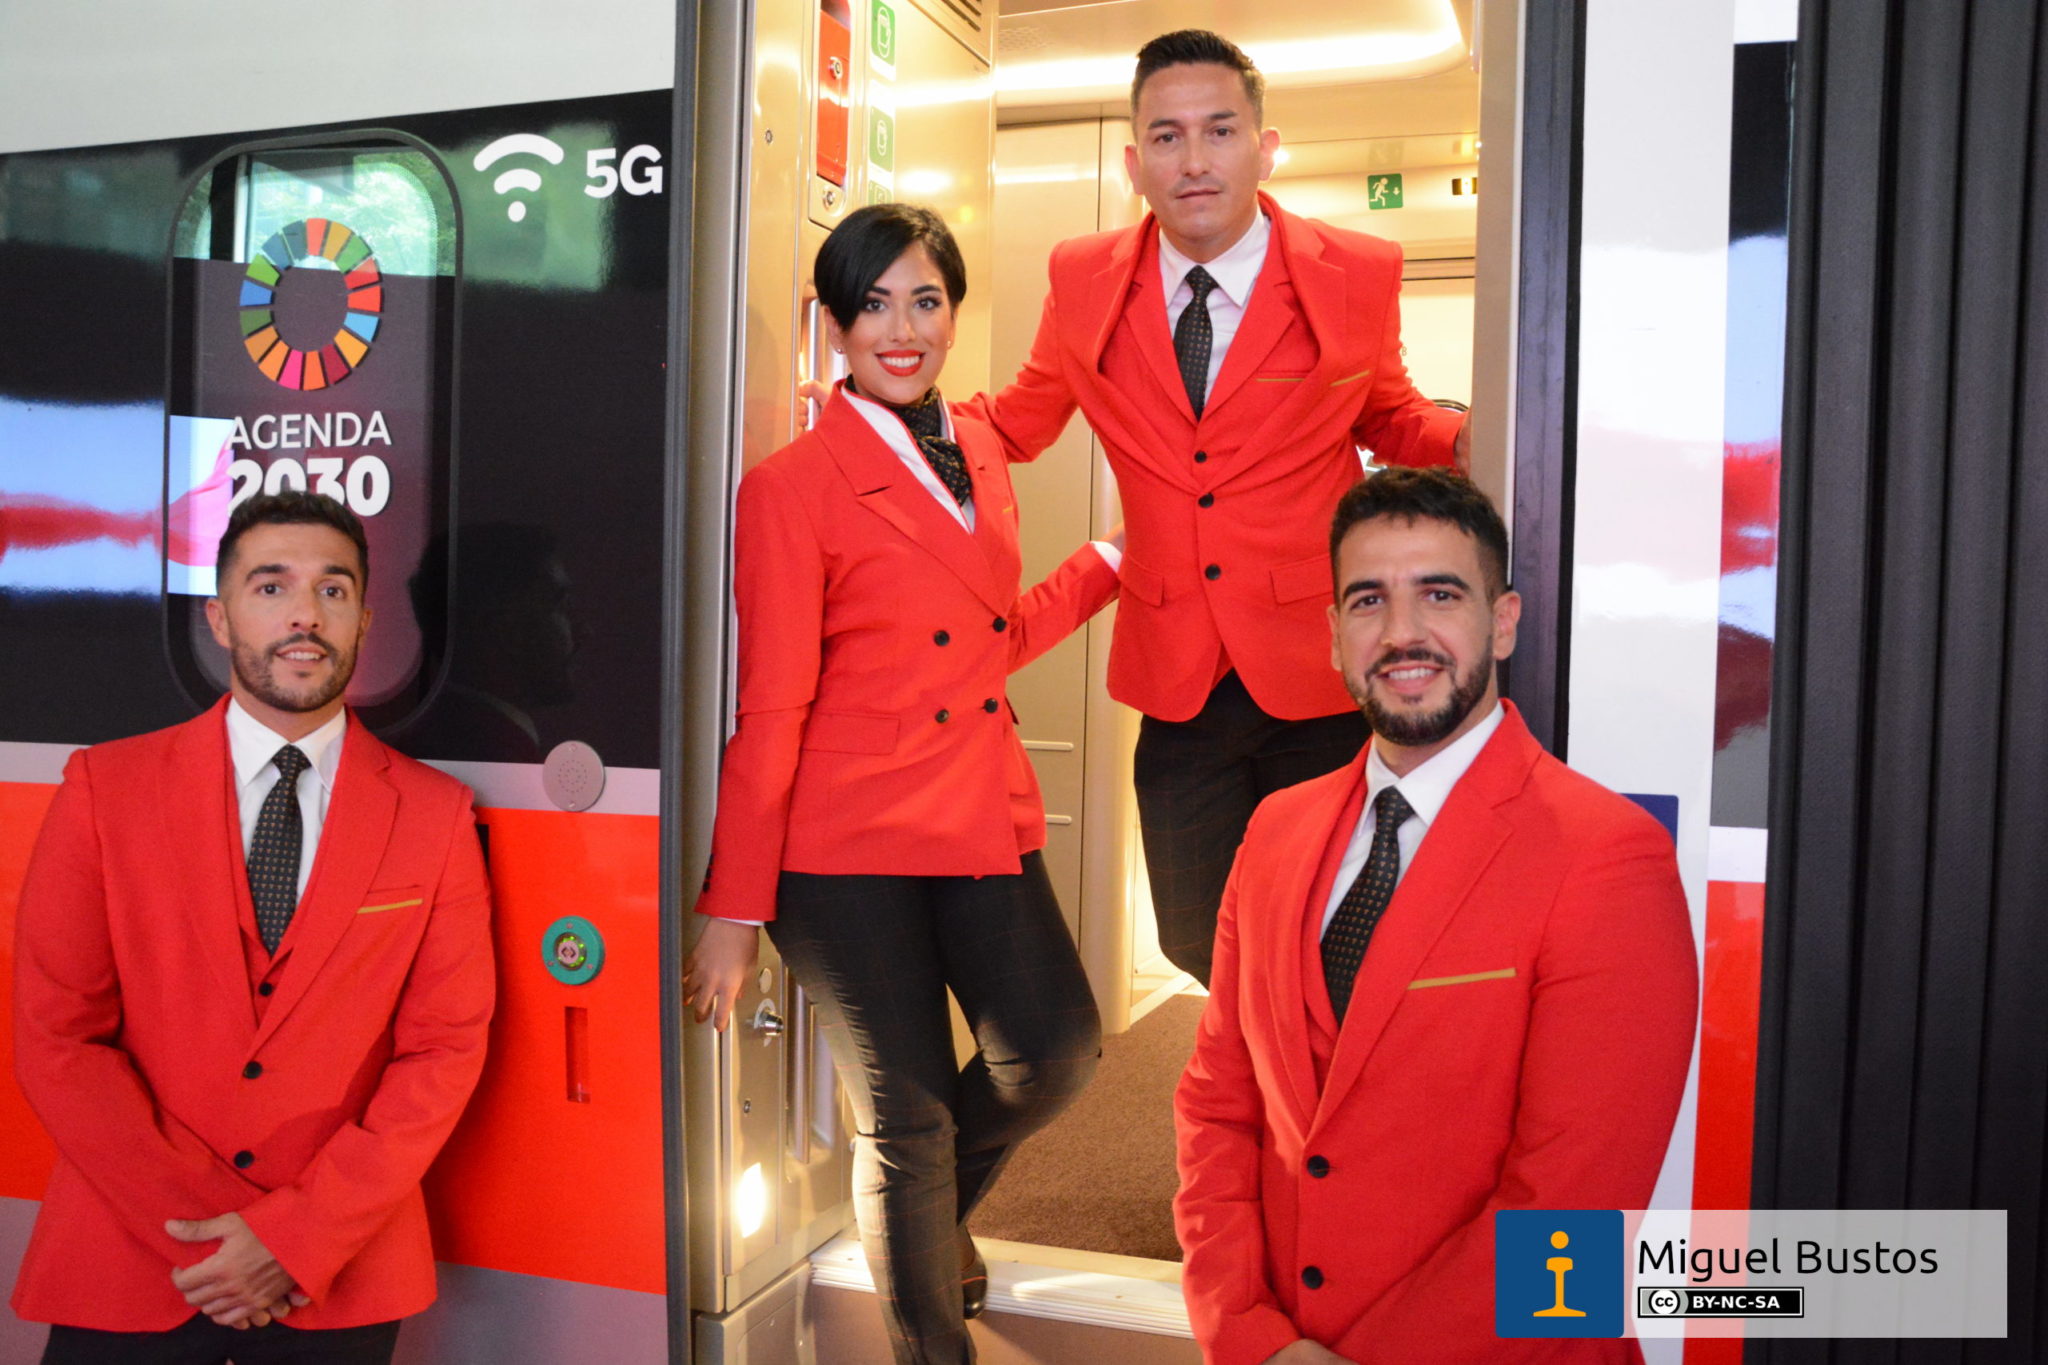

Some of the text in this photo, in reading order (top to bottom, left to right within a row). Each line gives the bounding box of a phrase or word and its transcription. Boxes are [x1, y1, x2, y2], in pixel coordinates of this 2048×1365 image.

[584, 144, 663, 198] 5G
[230, 410, 392, 450] AGENDA
[226, 455, 390, 517] 2030
